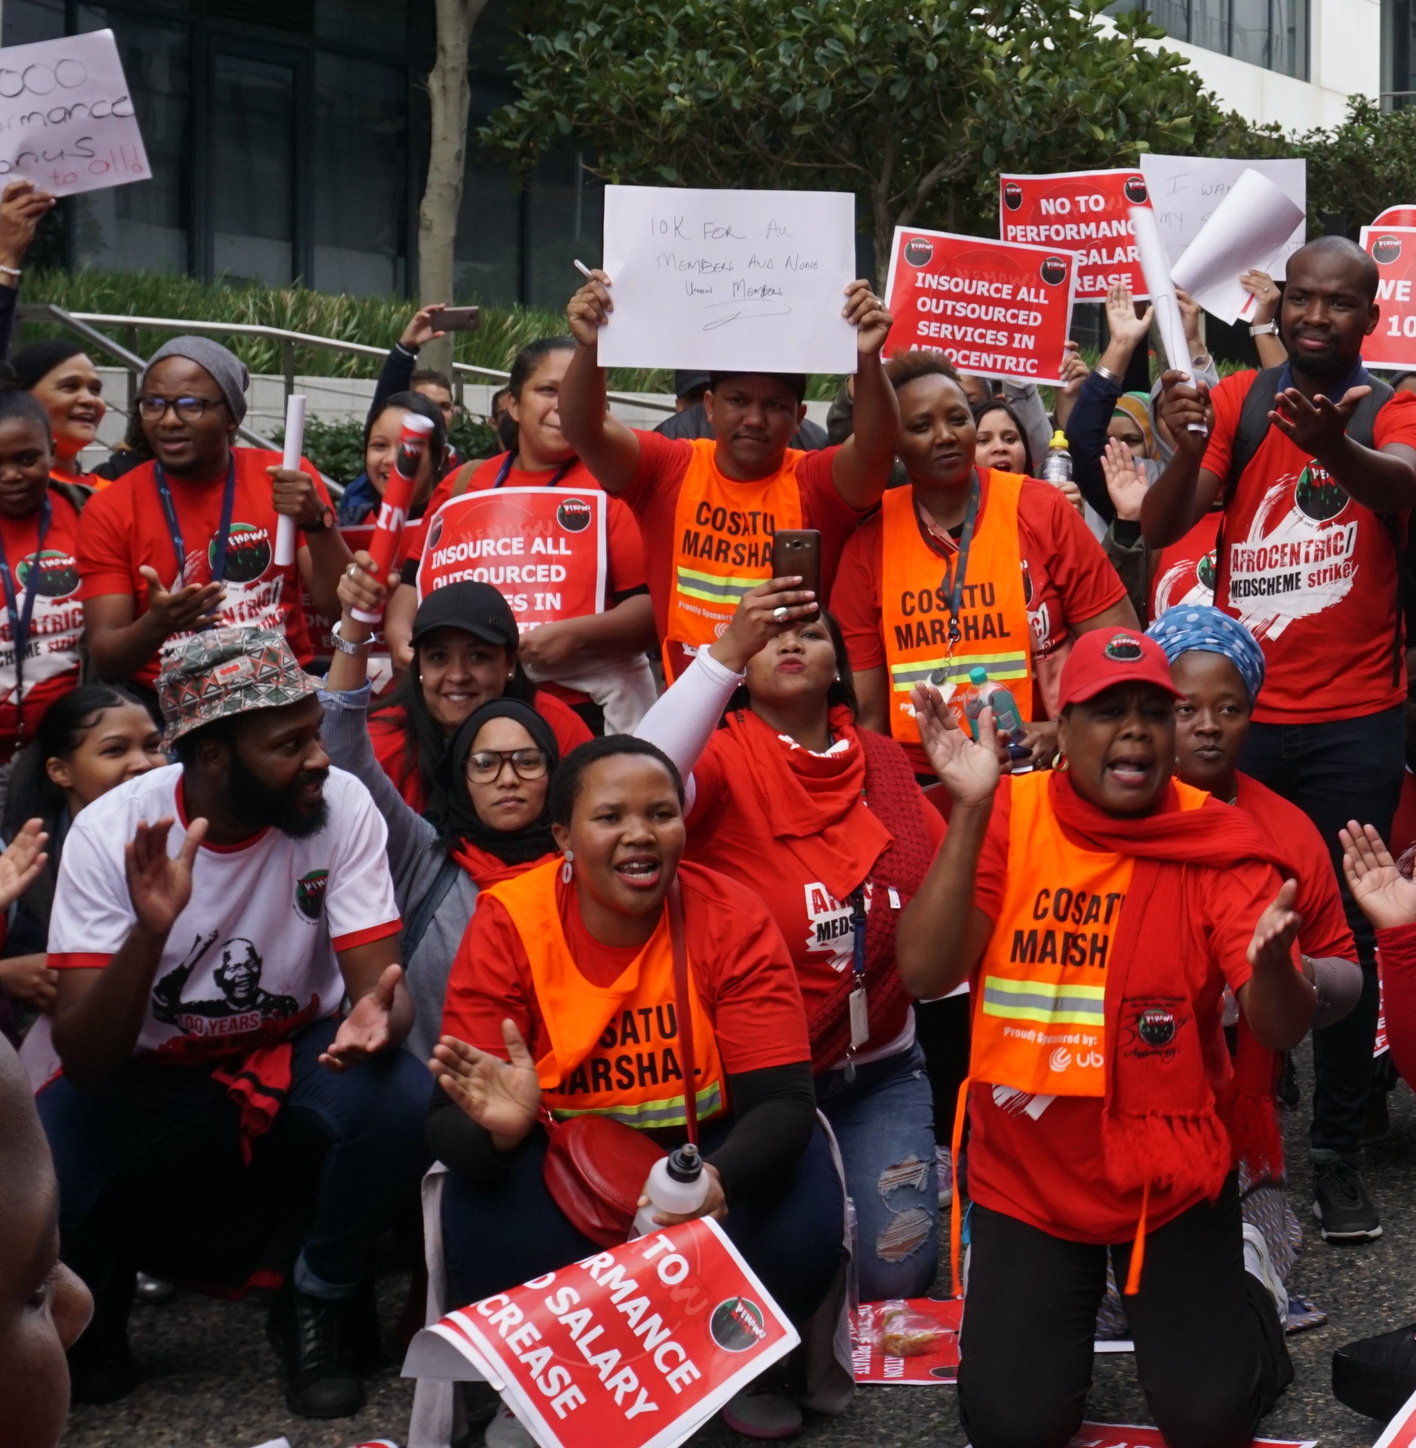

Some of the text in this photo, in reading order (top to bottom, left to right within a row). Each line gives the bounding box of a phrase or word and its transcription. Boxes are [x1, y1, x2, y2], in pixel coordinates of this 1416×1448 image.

[0, 96, 136, 129] rmance
[53, 168, 78, 185] to
[1040, 194, 1105, 216] NO TO
[652, 216, 690, 240] 10K
[704, 222, 746, 240] FOR
[1007, 218, 1138, 242] PERFORMANC
[1077, 245, 1142, 266] SALAR
[914, 272, 1049, 304] INSOURCE ALL
[1074, 273, 1133, 293] REASE
[1375, 279, 1411, 302] WE
[916, 297, 1042, 327] OUTSOURCED
[916, 320, 1036, 350] SERVICES IN
[696, 501, 776, 537] COSATU
[228, 528, 268, 547] EHAWU
[431, 537, 571, 569] INSOURCE ALL
[682, 529, 773, 568] MARSHA
[433, 565, 566, 589] OUTSOURCED
[1231, 561, 1351, 598] MEDSCHEME strike
[534, 593, 561, 610] IN
[894, 613, 1011, 651] MARSHAL
[1010, 929, 1108, 968] MARSH
[208, 1012, 260, 1033] YEARS
[599, 1003, 679, 1049] SATU
[642, 1234, 690, 1285] TO
[579, 1252, 702, 1394] RMANCE
[477, 1293, 587, 1420] CREASE
[544, 1287, 659, 1420] SALARY
